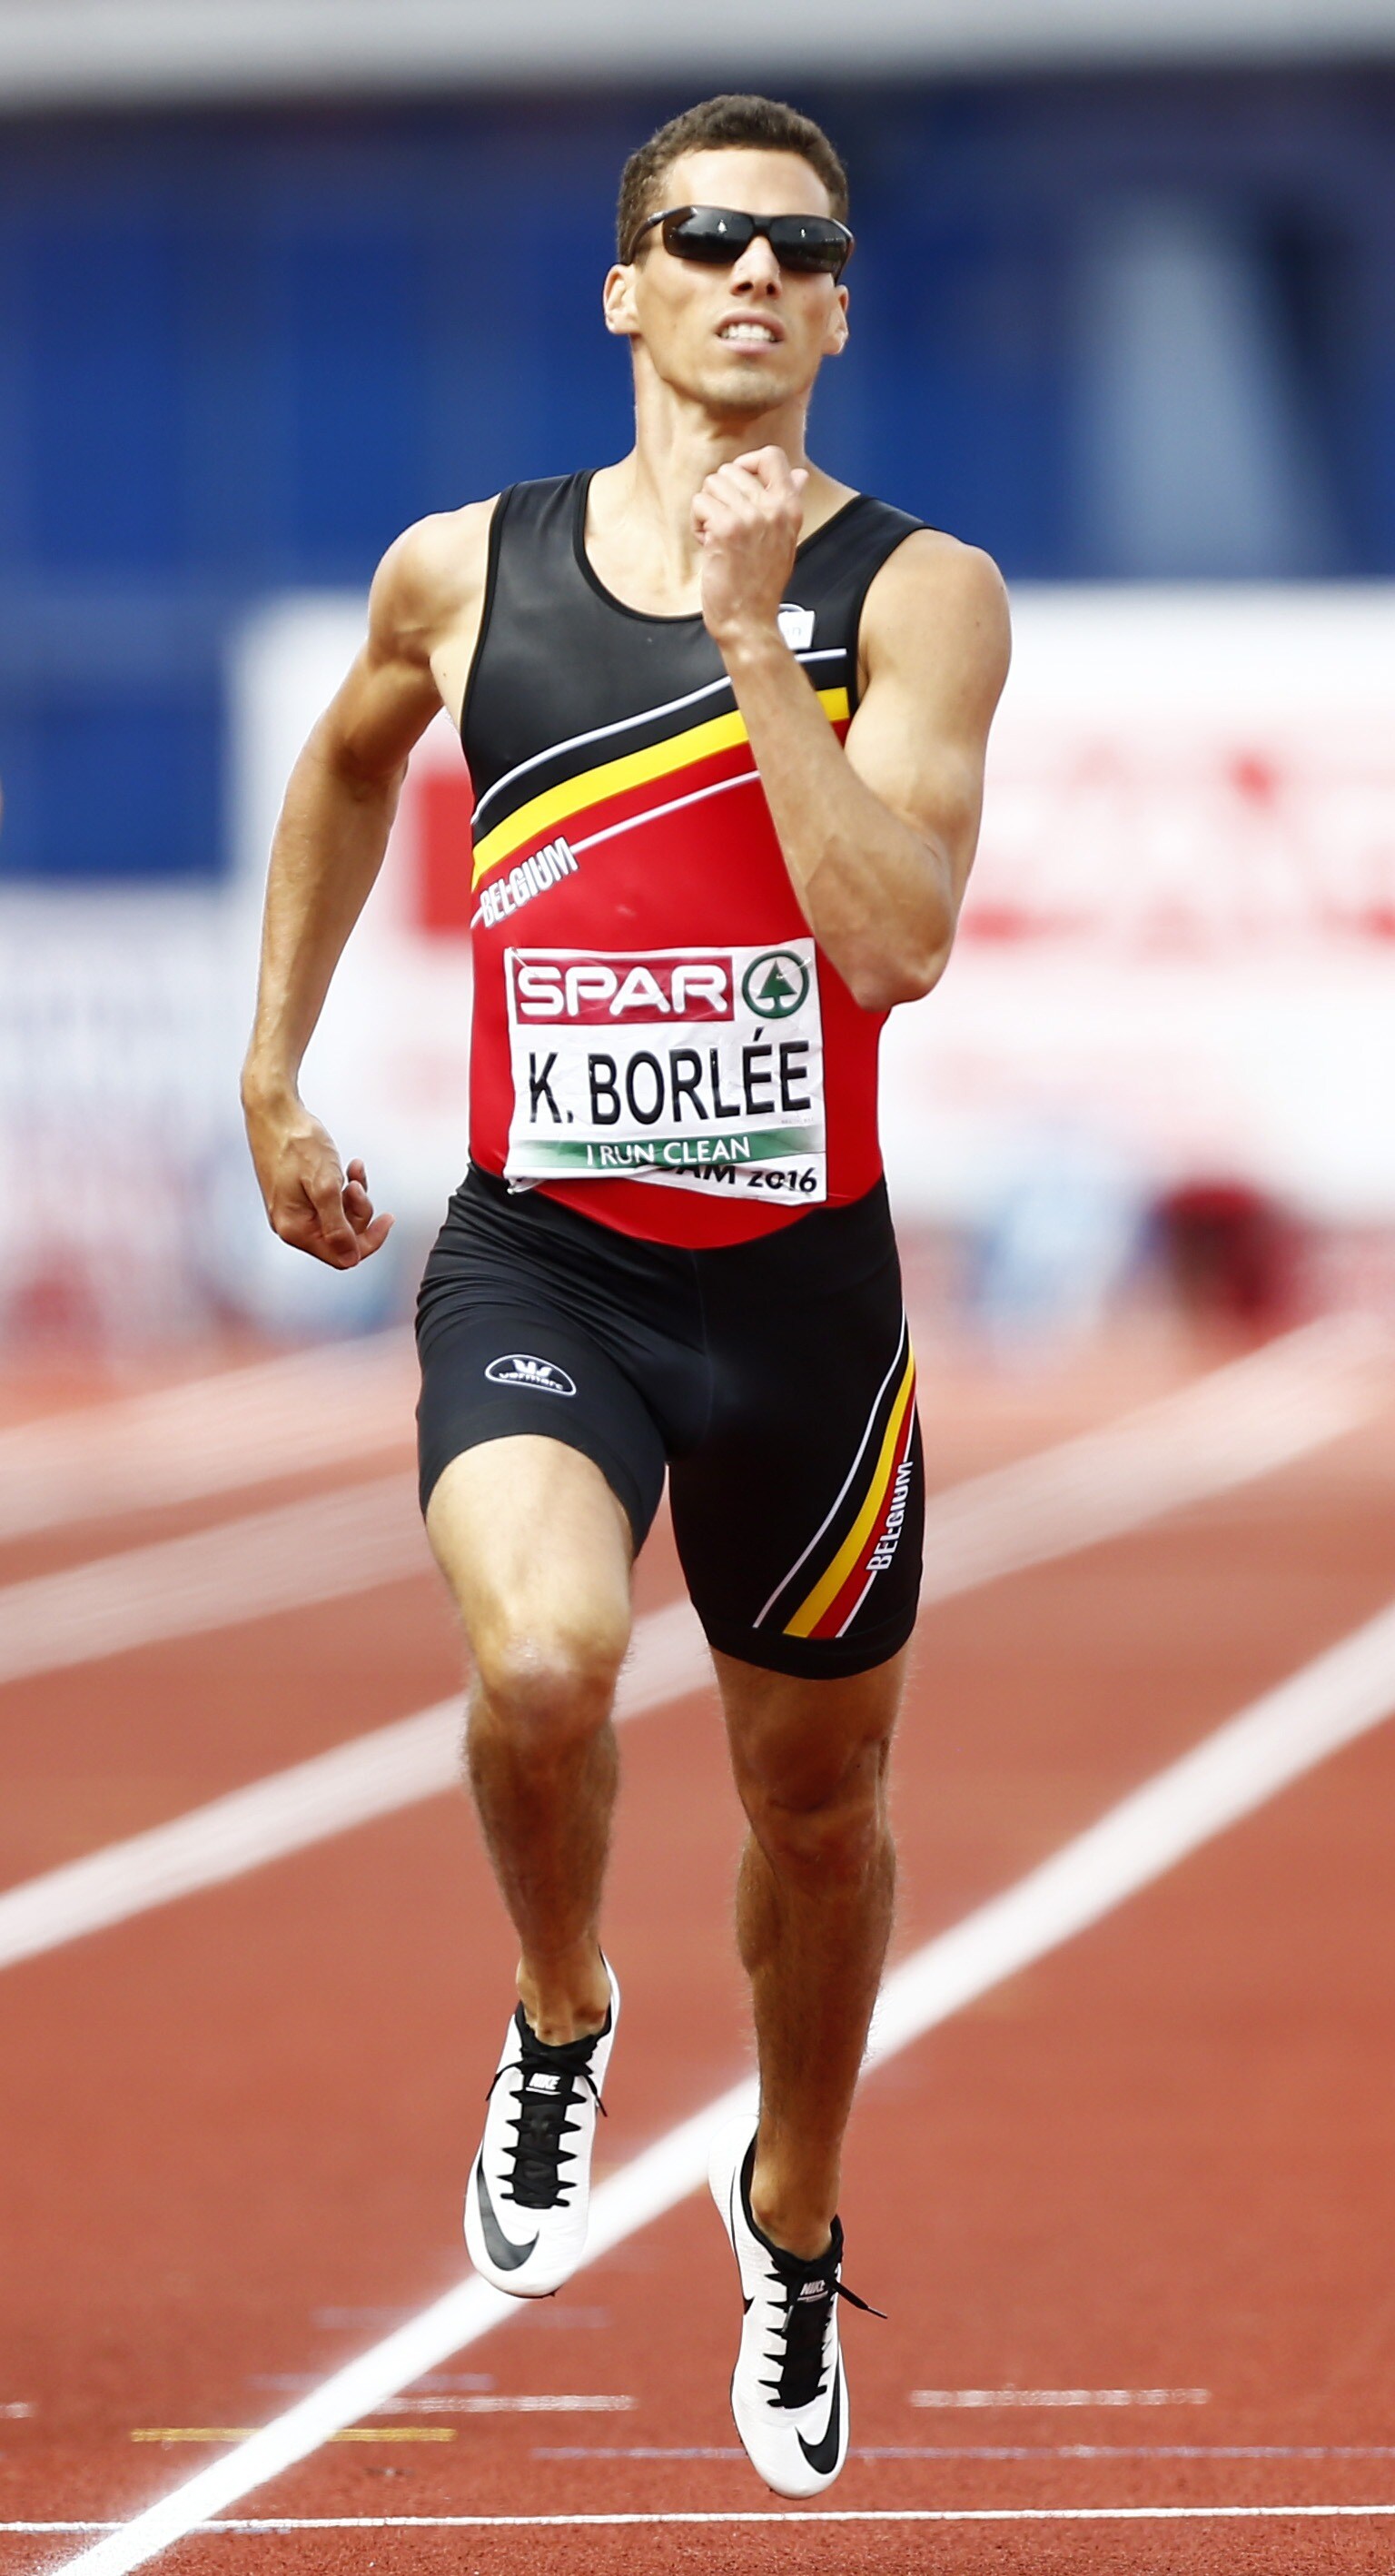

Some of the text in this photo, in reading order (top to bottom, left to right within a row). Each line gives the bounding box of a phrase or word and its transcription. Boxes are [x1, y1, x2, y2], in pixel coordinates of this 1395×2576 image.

[480, 836, 579, 927] BELGIUM
[518, 965, 727, 1016] SPAR
[529, 1026, 811, 1125] K. BORLÉE
[600, 1144, 655, 1165] RUN
[663, 1136, 751, 1164] CLEAN
[747, 1167, 817, 1193] 2016
[866, 1461, 914, 1570] BELGIUM
[529, 2072, 561, 2091] NIKE
[799, 2279, 826, 2296] NIKE
